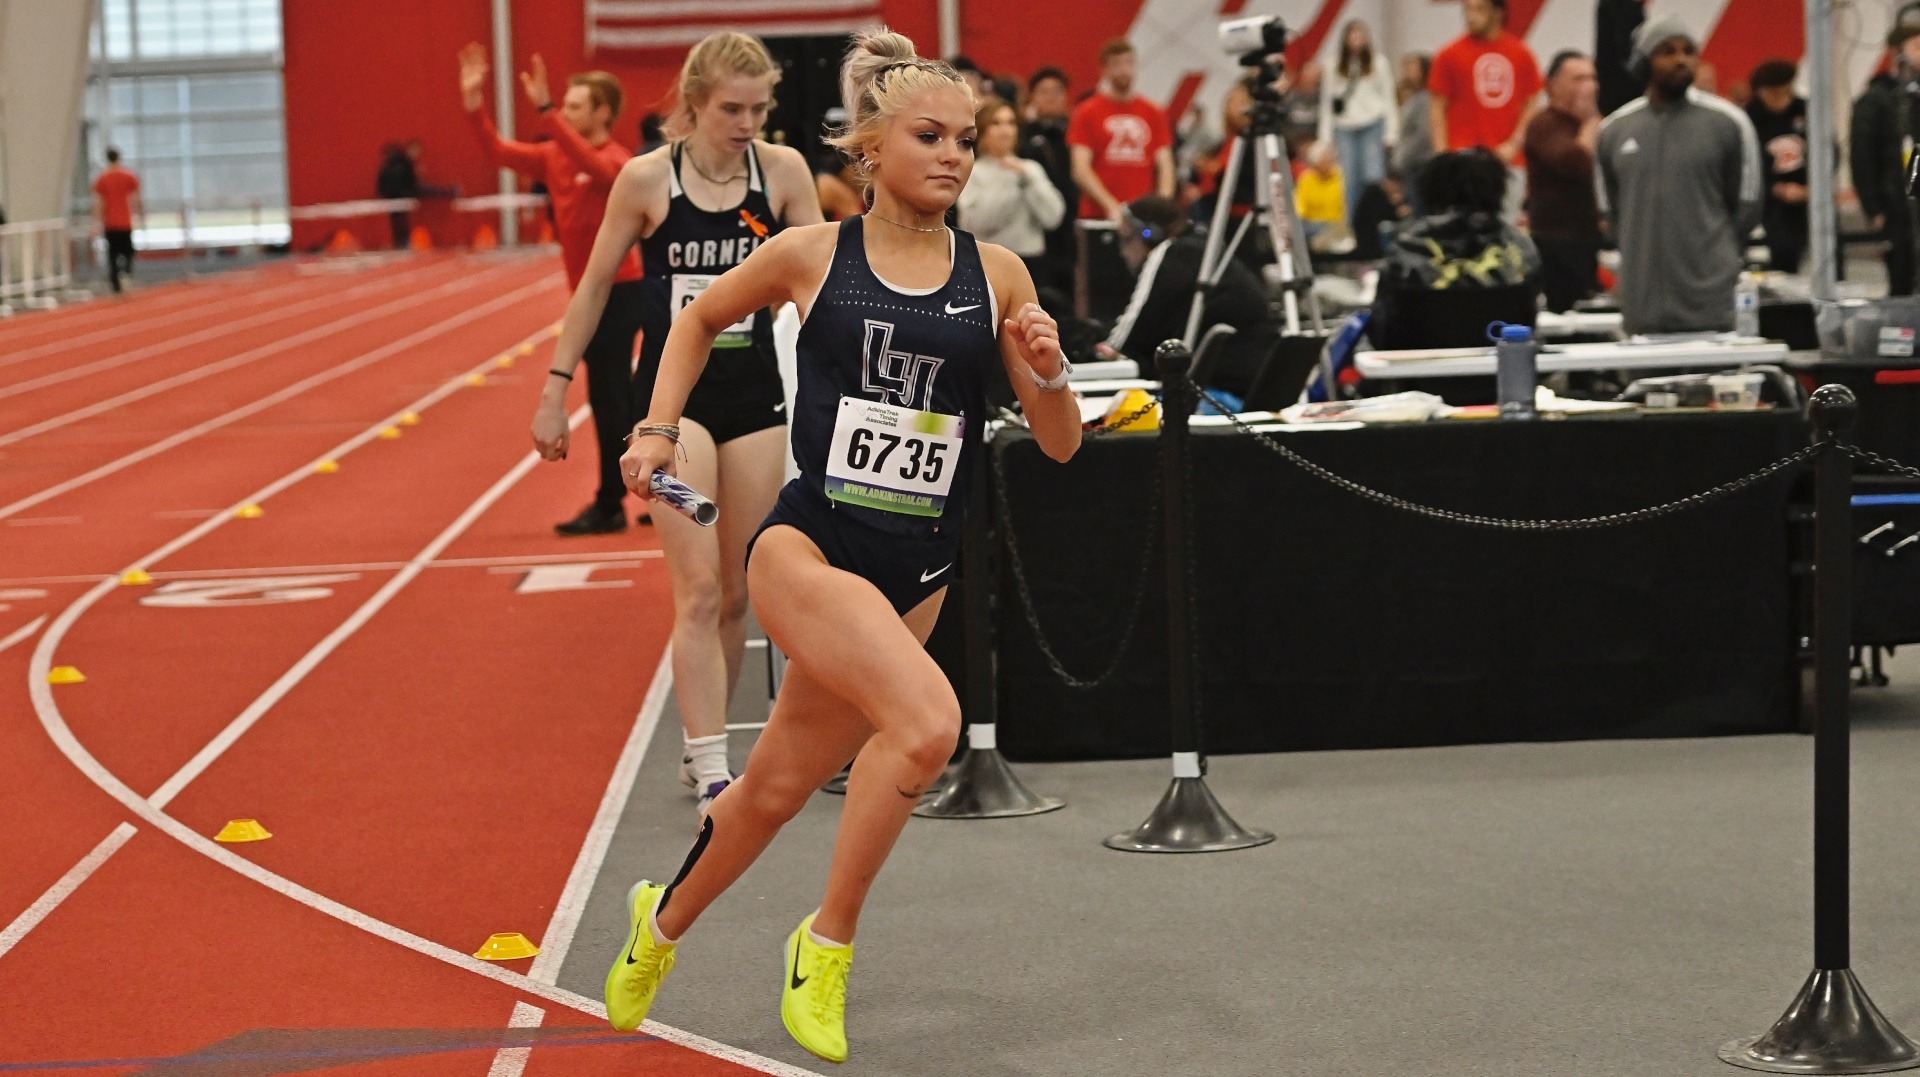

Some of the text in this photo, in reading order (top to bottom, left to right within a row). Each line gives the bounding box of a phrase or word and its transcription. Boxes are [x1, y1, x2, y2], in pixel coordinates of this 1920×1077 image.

[668, 236, 770, 268] CORNE
[865, 416, 897, 427] Associates
[879, 414, 898, 422] Timing
[847, 427, 948, 483] 6735
[843, 482, 933, 508] WWW.ADKINSTRAK.COM
